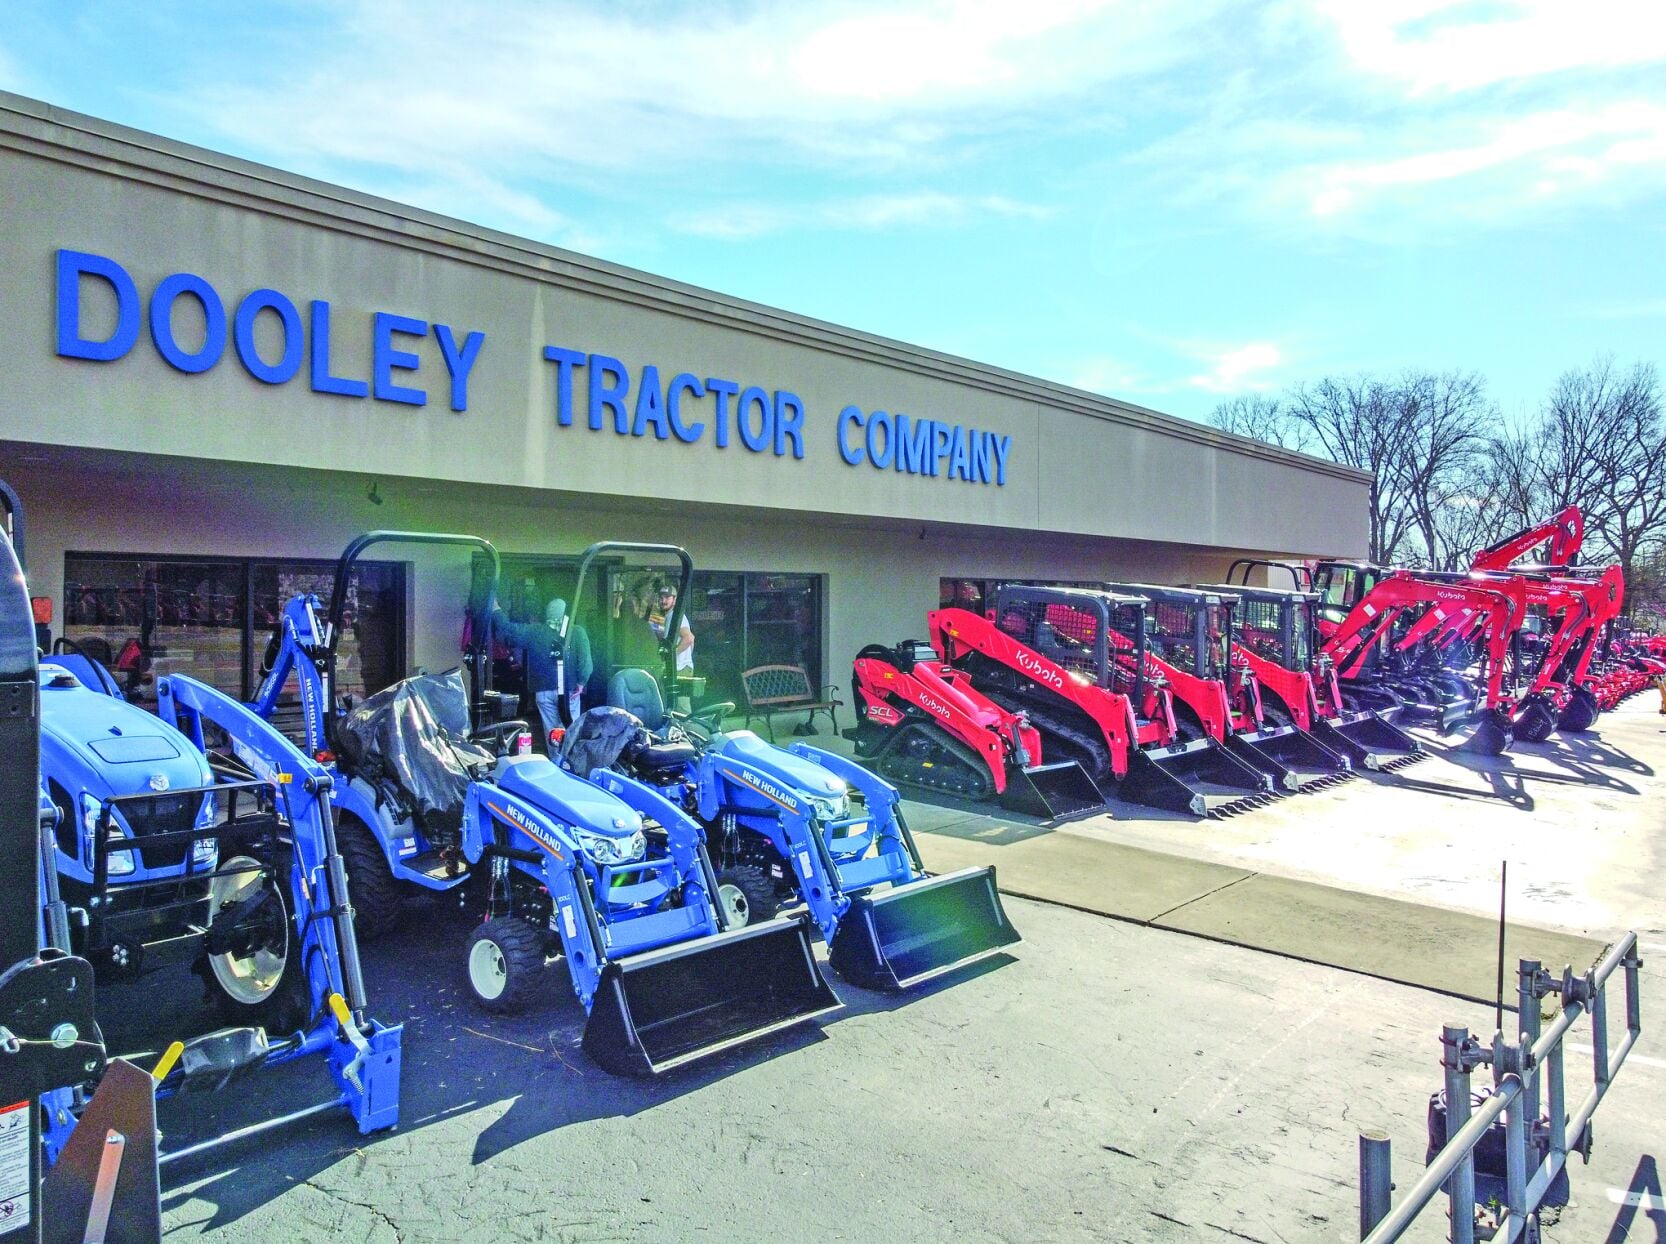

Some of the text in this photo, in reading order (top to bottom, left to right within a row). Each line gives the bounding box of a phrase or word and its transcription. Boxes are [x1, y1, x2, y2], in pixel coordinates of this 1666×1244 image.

[55, 248, 1012, 486] DOOLEY TRACTOR COMPANY
[1437, 591, 1466, 600] Kubota
[1015, 650, 1063, 689] Kubota
[306, 678, 314, 703] NEW
[919, 692, 951, 719] Kubota
[869, 705, 893, 717] SCL
[742, 769, 797, 808] NEW HOLLAND
[506, 804, 561, 852] NEW HOLLAND
